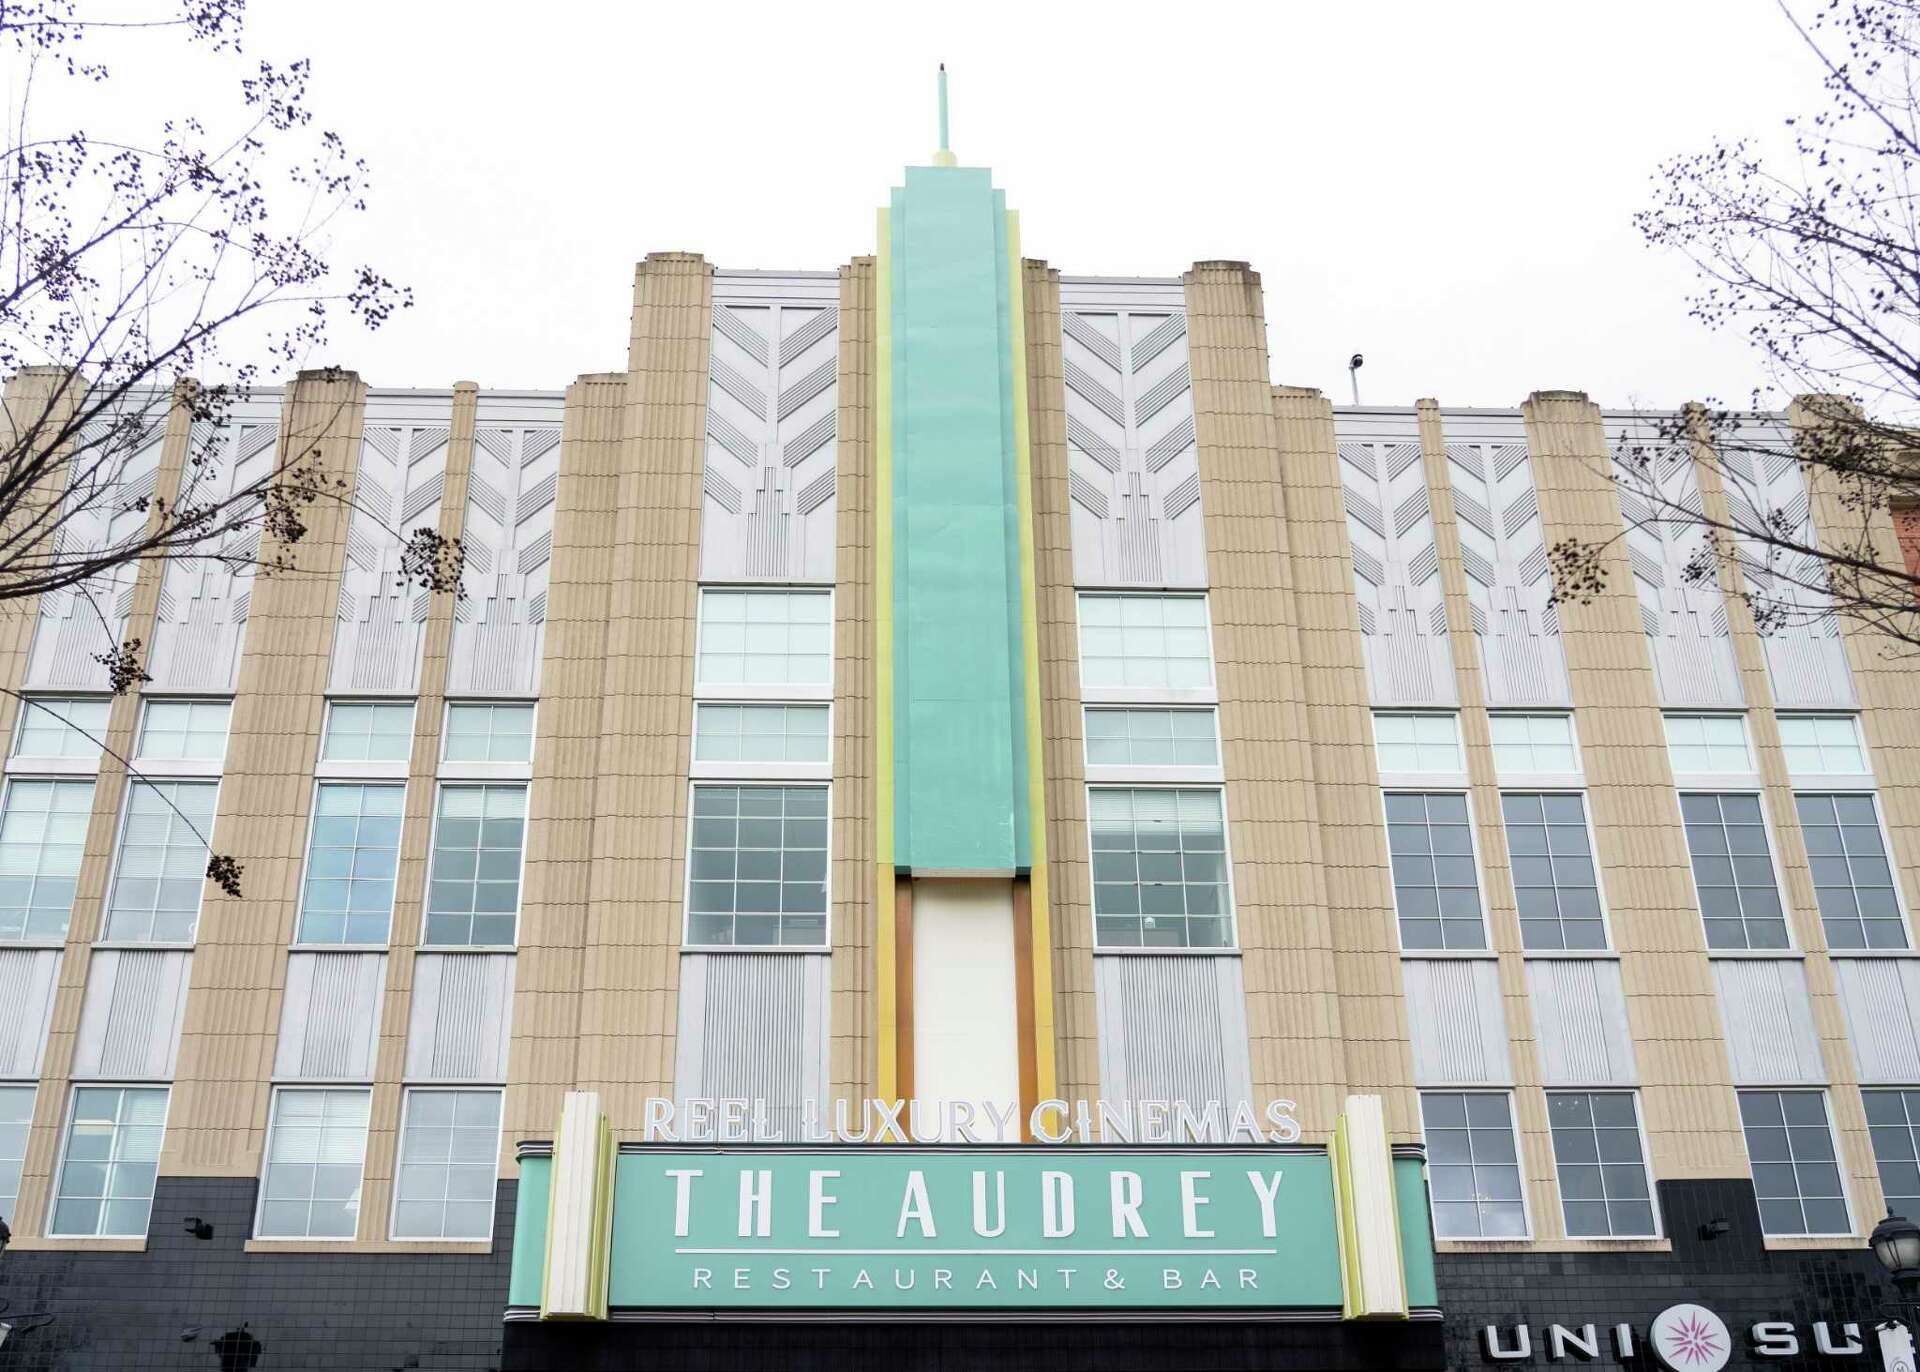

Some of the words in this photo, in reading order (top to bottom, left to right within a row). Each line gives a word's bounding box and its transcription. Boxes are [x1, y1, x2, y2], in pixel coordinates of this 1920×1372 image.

[644, 1098, 783, 1143] REEL
[801, 1098, 1017, 1143] LUXURY
[1029, 1099, 1301, 1144] CINEMAS
[665, 1169, 841, 1238] THE
[896, 1170, 1283, 1238] AUDREY
[693, 1268, 1077, 1289] RESTAURANT
[1103, 1268, 1125, 1290] &
[1163, 1269, 1259, 1289] BAR
[1486, 1323, 1634, 1358] UNI
[1752, 1321, 1916, 1355] SU
